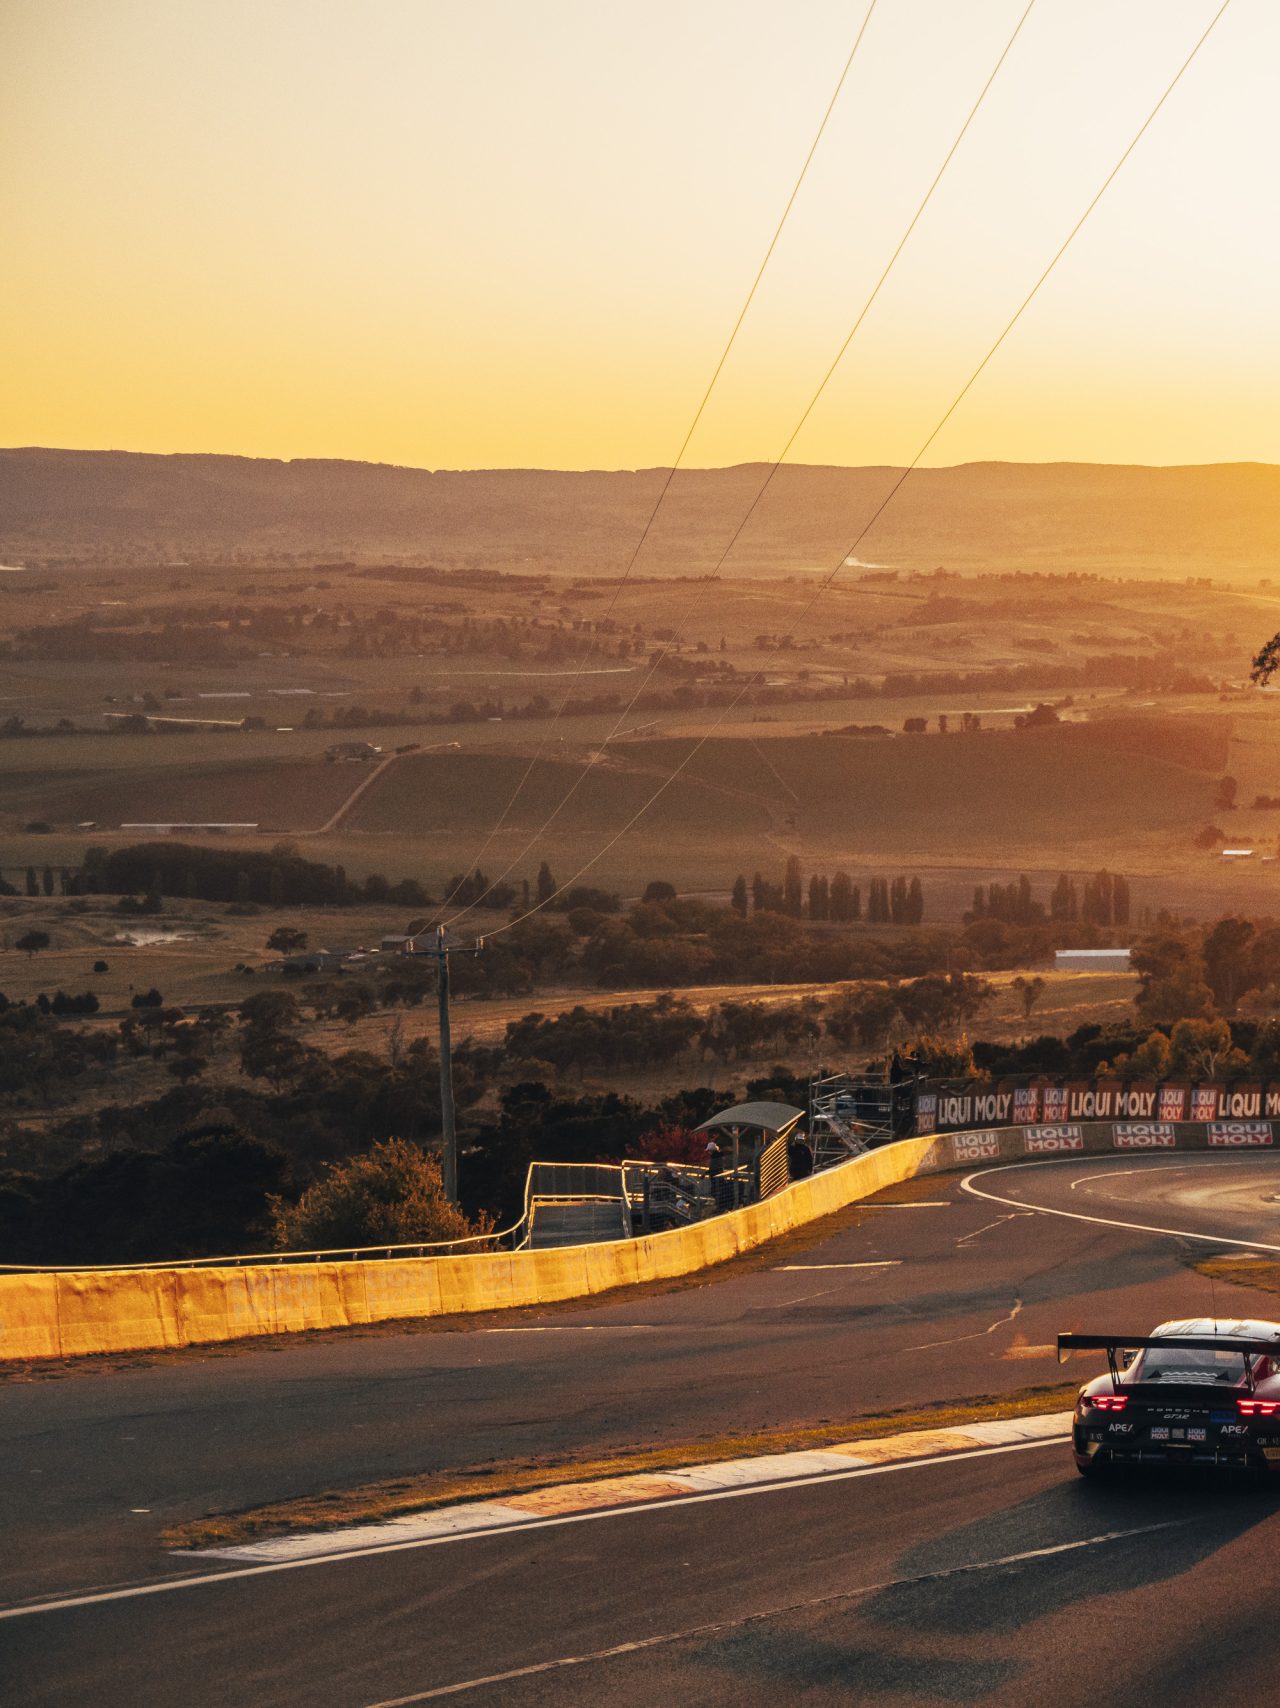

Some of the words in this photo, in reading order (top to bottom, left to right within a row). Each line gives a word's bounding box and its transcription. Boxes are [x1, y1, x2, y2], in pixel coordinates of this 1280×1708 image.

[1044, 1089, 1068, 1105] LIQUI
[1160, 1090, 1183, 1105] LIQUI
[938, 1097, 971, 1124] LIQUI
[974, 1094, 1012, 1120] MOLY
[1070, 1091, 1111, 1118] LIQUI
[1115, 1091, 1156, 1116] MOLY
[1219, 1093, 1260, 1117] LIQUI
[1043, 1106, 1067, 1120] MOLY
[1159, 1106, 1182, 1120] MOLY
[1027, 1126, 1079, 1139] LIQUI
[1116, 1124, 1171, 1135] LIQUI
[1211, 1123, 1268, 1134] LIQUI
[954, 1133, 995, 1147] LIQUI
[1028, 1138, 1080, 1151] MOLY
[1117, 1135, 1173, 1145] MOLY
[1212, 1134, 1269, 1144] MOLY
[955, 1145, 996, 1160] MOLY
